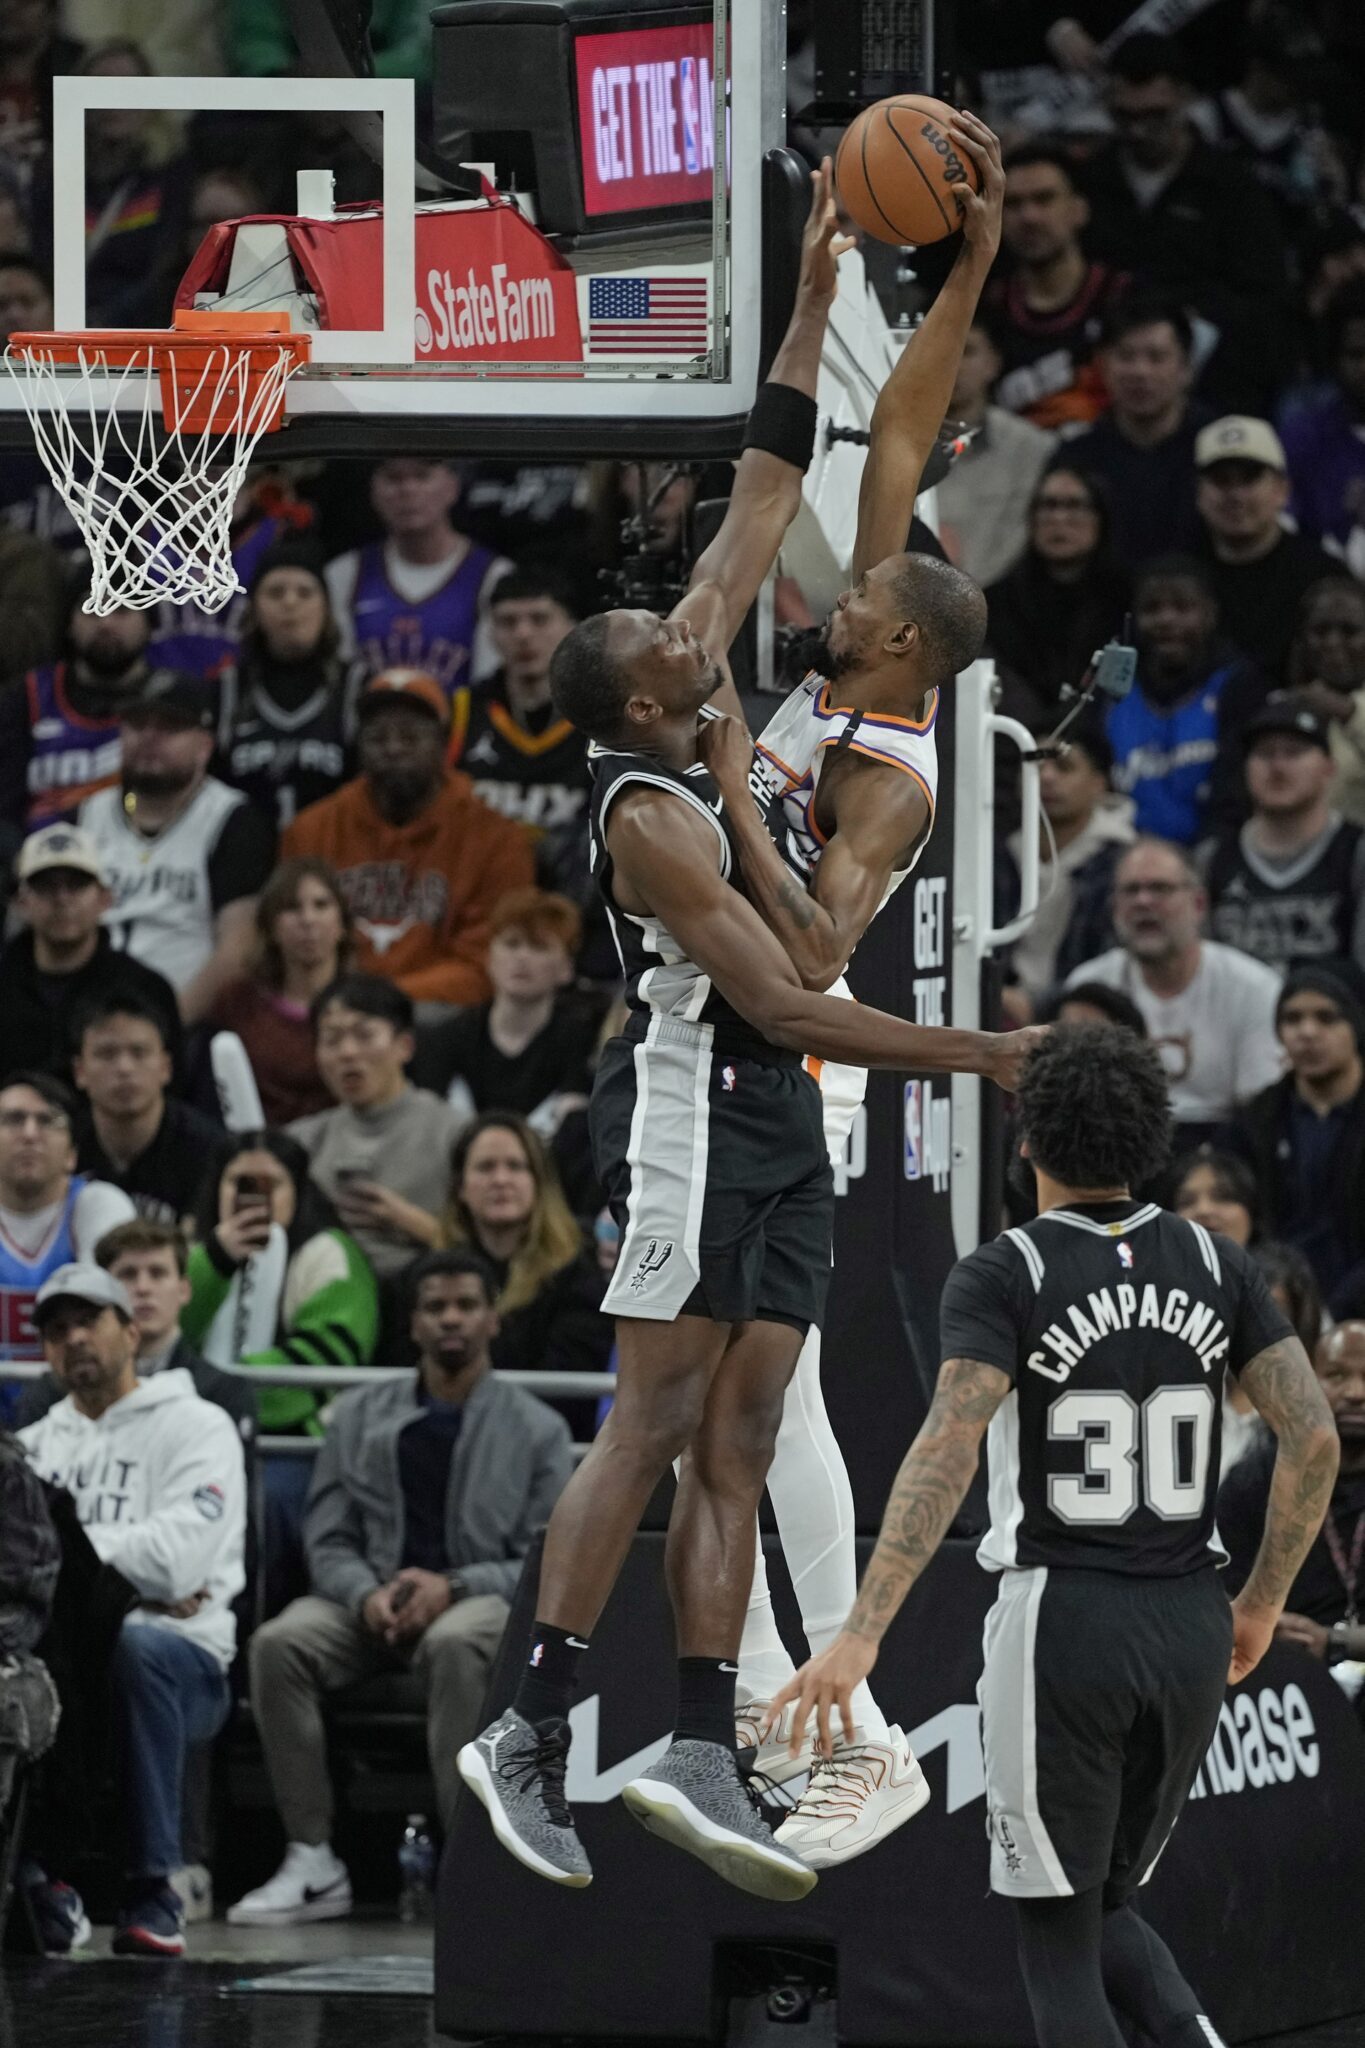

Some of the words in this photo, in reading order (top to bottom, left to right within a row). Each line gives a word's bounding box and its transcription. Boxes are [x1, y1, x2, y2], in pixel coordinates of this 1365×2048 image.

[592, 65, 634, 183] GET
[635, 61, 681, 176] THE
[914, 877, 947, 970] GET
[1027, 1283, 1230, 1383] CHAMPAGNIE
[1047, 1383, 1216, 1526] 30
